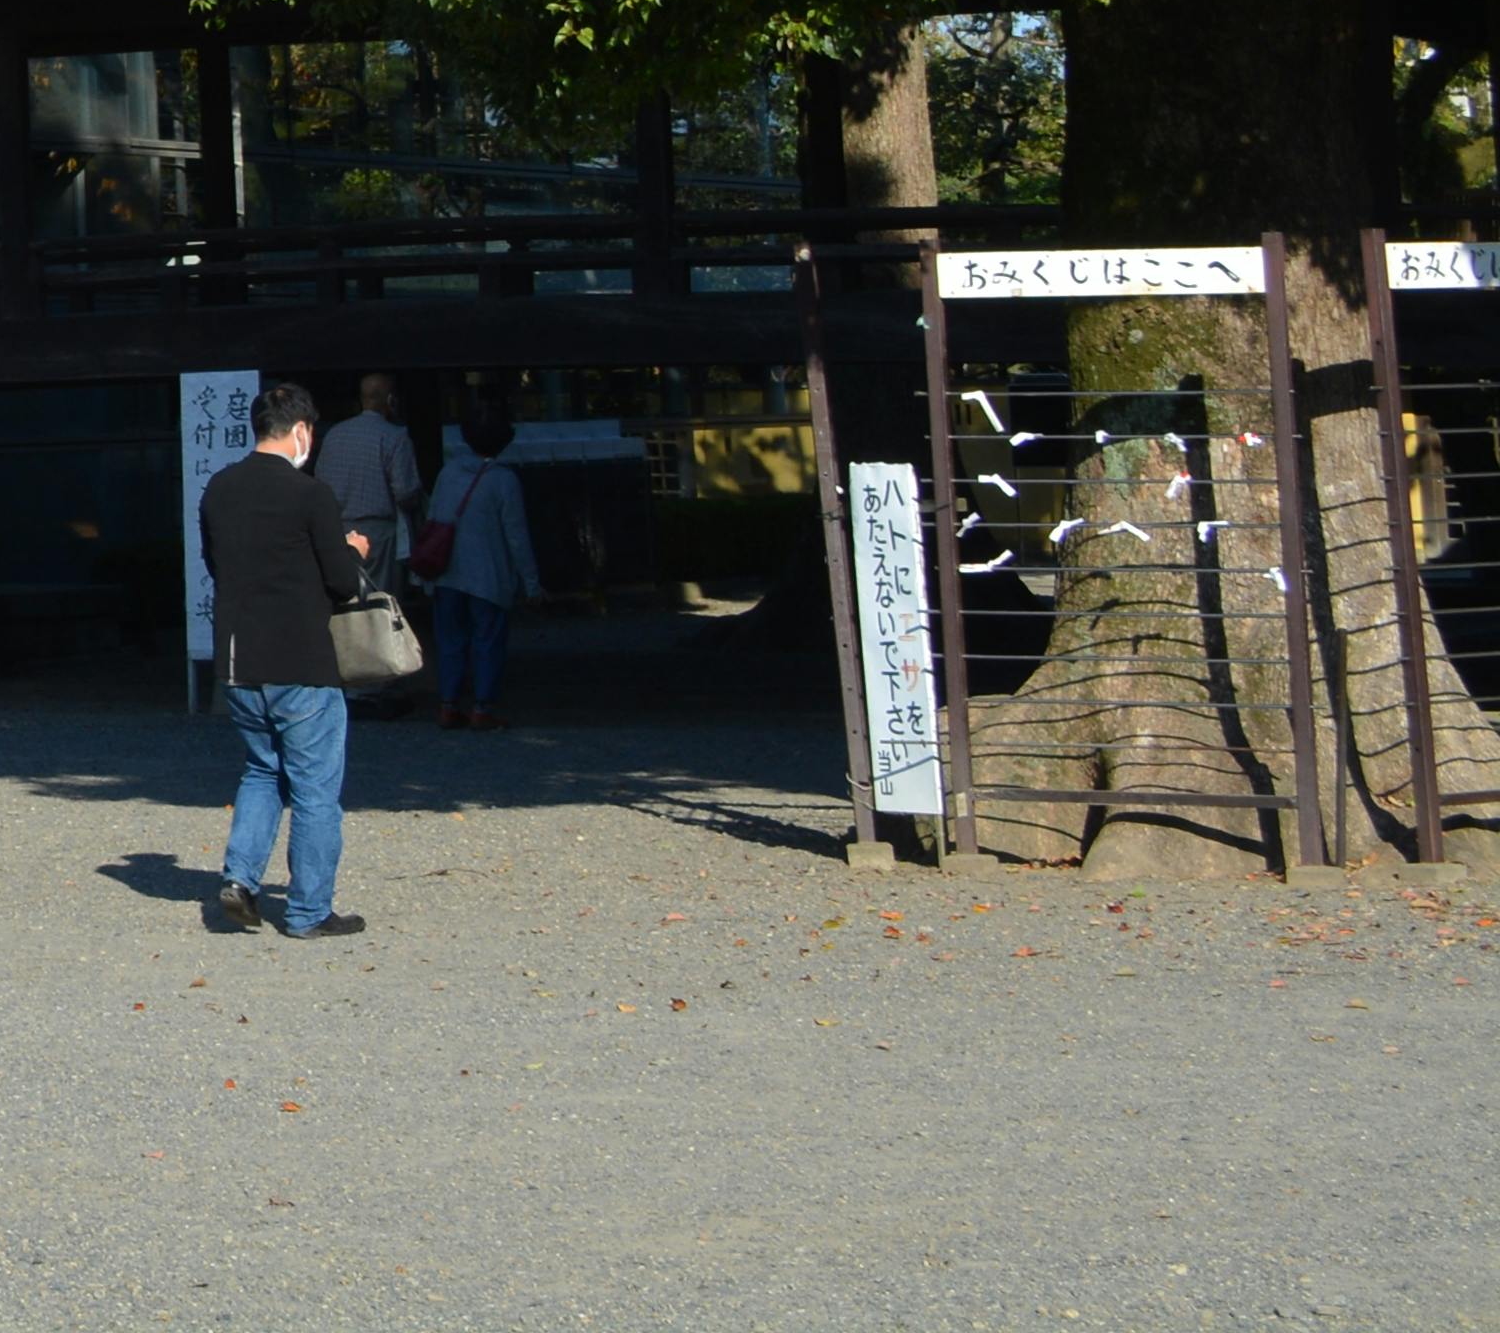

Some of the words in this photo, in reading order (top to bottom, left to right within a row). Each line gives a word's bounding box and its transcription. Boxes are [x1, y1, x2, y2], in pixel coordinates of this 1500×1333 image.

[962, 257, 1241, 289] おみくじはここへ
[220, 387, 250, 449] 庭園
